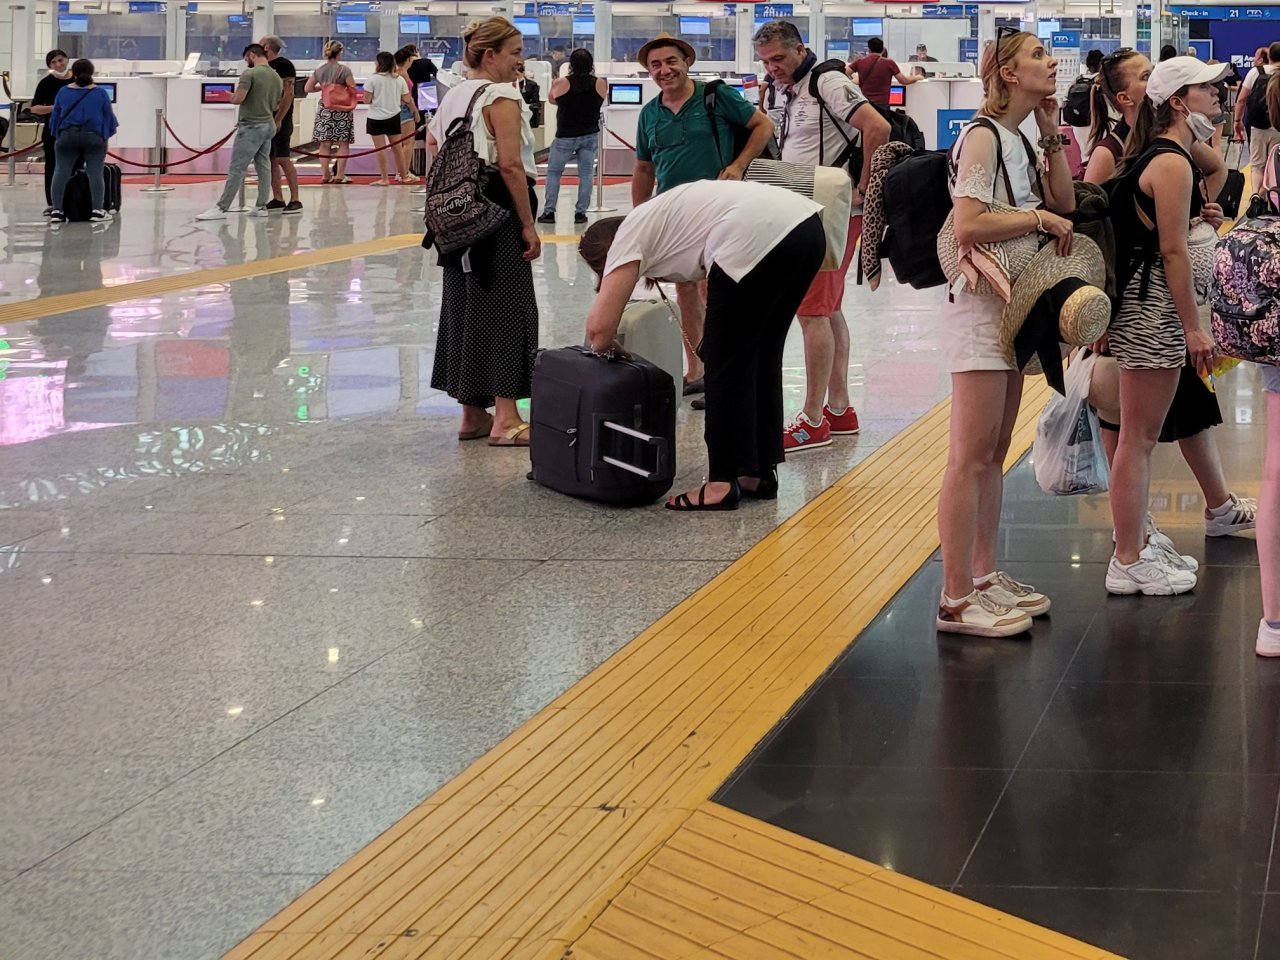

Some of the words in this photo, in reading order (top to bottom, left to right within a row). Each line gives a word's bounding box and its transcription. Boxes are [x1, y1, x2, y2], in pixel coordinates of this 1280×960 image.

[936, 6, 948, 15] 24
[437, 202, 454, 215] Hard
[454, 194, 472, 208] Rock
